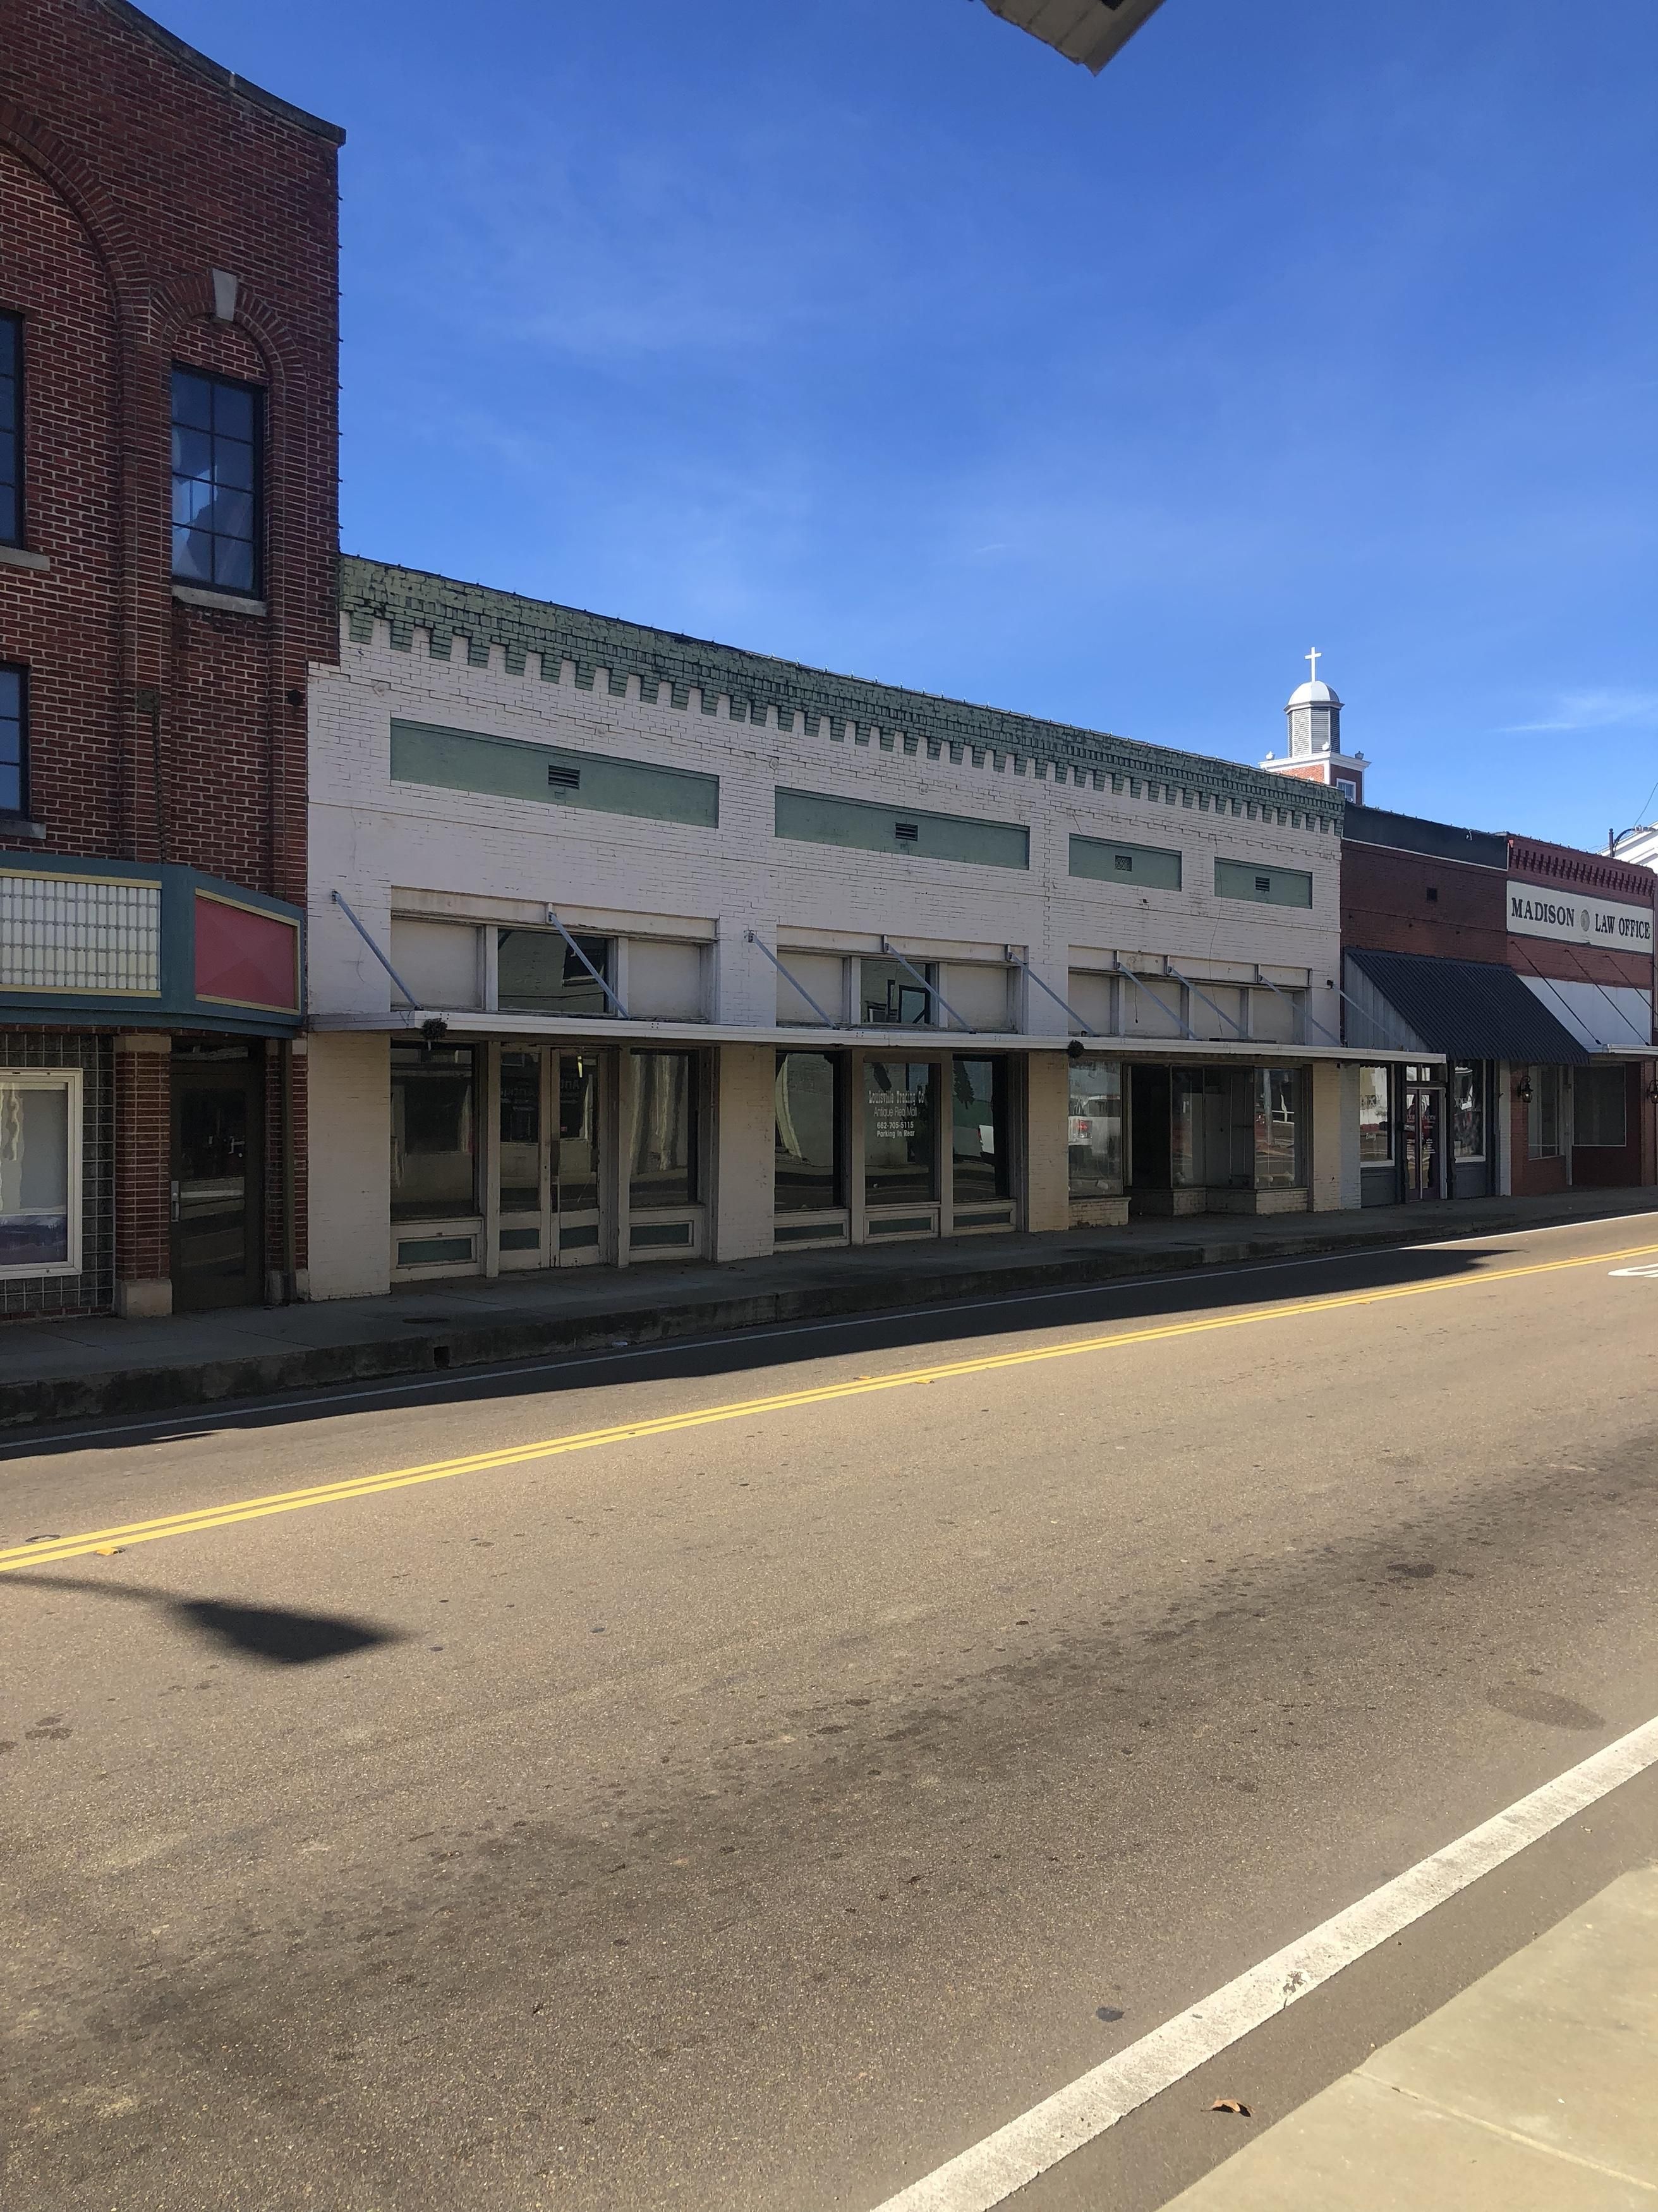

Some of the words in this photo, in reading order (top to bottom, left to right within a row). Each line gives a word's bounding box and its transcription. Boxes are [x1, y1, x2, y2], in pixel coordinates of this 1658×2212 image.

[1511, 897, 1574, 927] MADISON
[1595, 913, 1615, 934] LAW
[1619, 918, 1650, 939] OFFICE
[869, 1090, 893, 1103] Louisville
[897, 1090, 916, 1105] Trading
[874, 1107, 893, 1118] Antique
[907, 1106, 917, 1117] Mall
